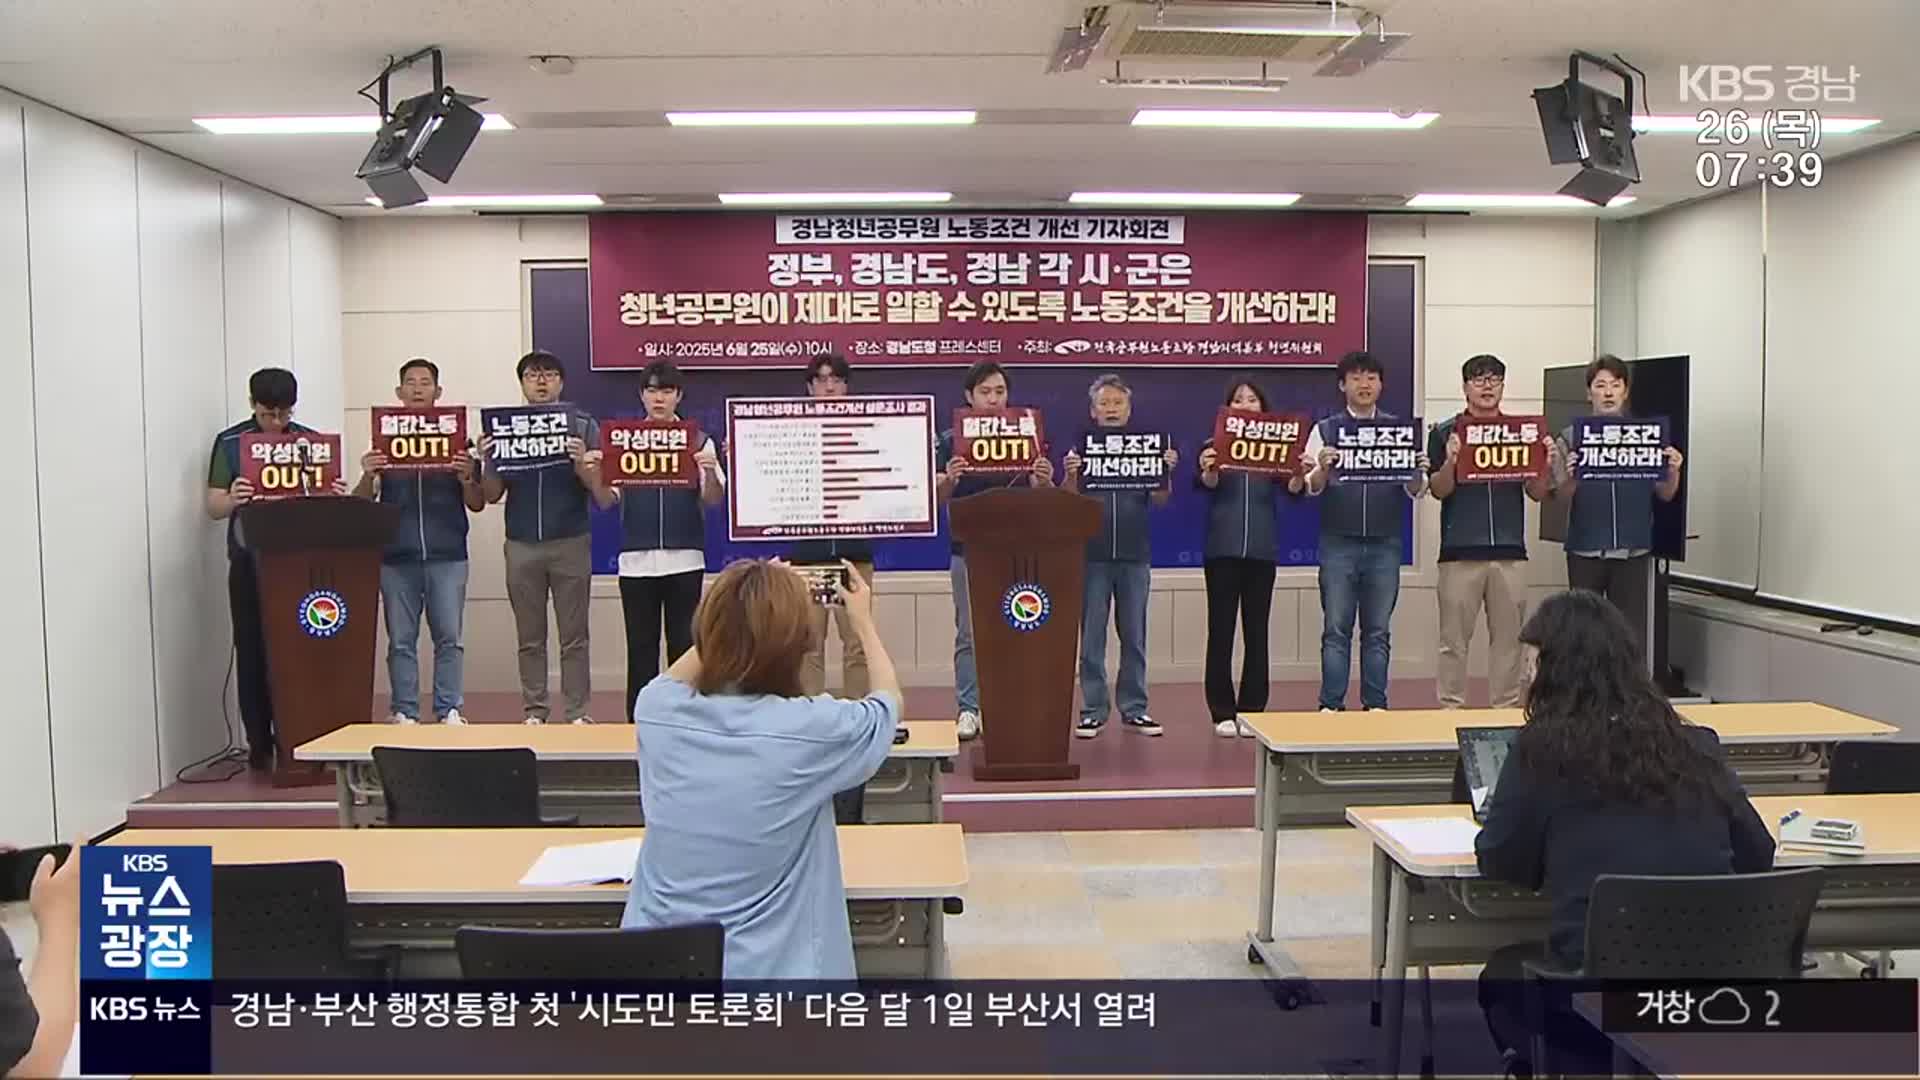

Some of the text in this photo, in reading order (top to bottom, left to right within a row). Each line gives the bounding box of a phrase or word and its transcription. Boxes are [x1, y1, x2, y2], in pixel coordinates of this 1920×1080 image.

[791, 217, 1170, 240] 경남청년공무원 노동조건 개선 기자회견
[768, 252, 843, 287] 정부,
[850, 252, 957, 286] 경남도,
[966, 252, 1030, 286] 경남
[1039, 251, 1073, 286] 각
[619, 290, 1336, 326] 청년공무원이 제대로 일할 수 있도록 노동조건을 개선하라!
[676, 341, 724, 357] 2025년
[726, 342, 748, 357] 6월
[939, 339, 1002, 354] 프레스센터
[491, 412, 569, 437] 노동조건
[1225, 416, 1299, 442] 악성민원
[1582, 425, 1661, 445] 노동조건
[391, 436, 449, 459] OUT!
[491, 434, 571, 459] 개선하라
[610, 428, 687, 450] 악성민원
[1085, 433, 1161, 455] 노동조건
[1337, 426, 1414, 447] 노동조건
[972, 438, 1030, 461] OUT!
[1230, 440, 1288, 463] OUT!
[1335, 448, 1417, 470] 개선하라!
[1475, 446, 1529, 469] OUT!
[1579, 446, 1663, 467] 개선하라!
[620, 452, 679, 474] OUT!
[1083, 456, 1163, 477] 개선하라!
